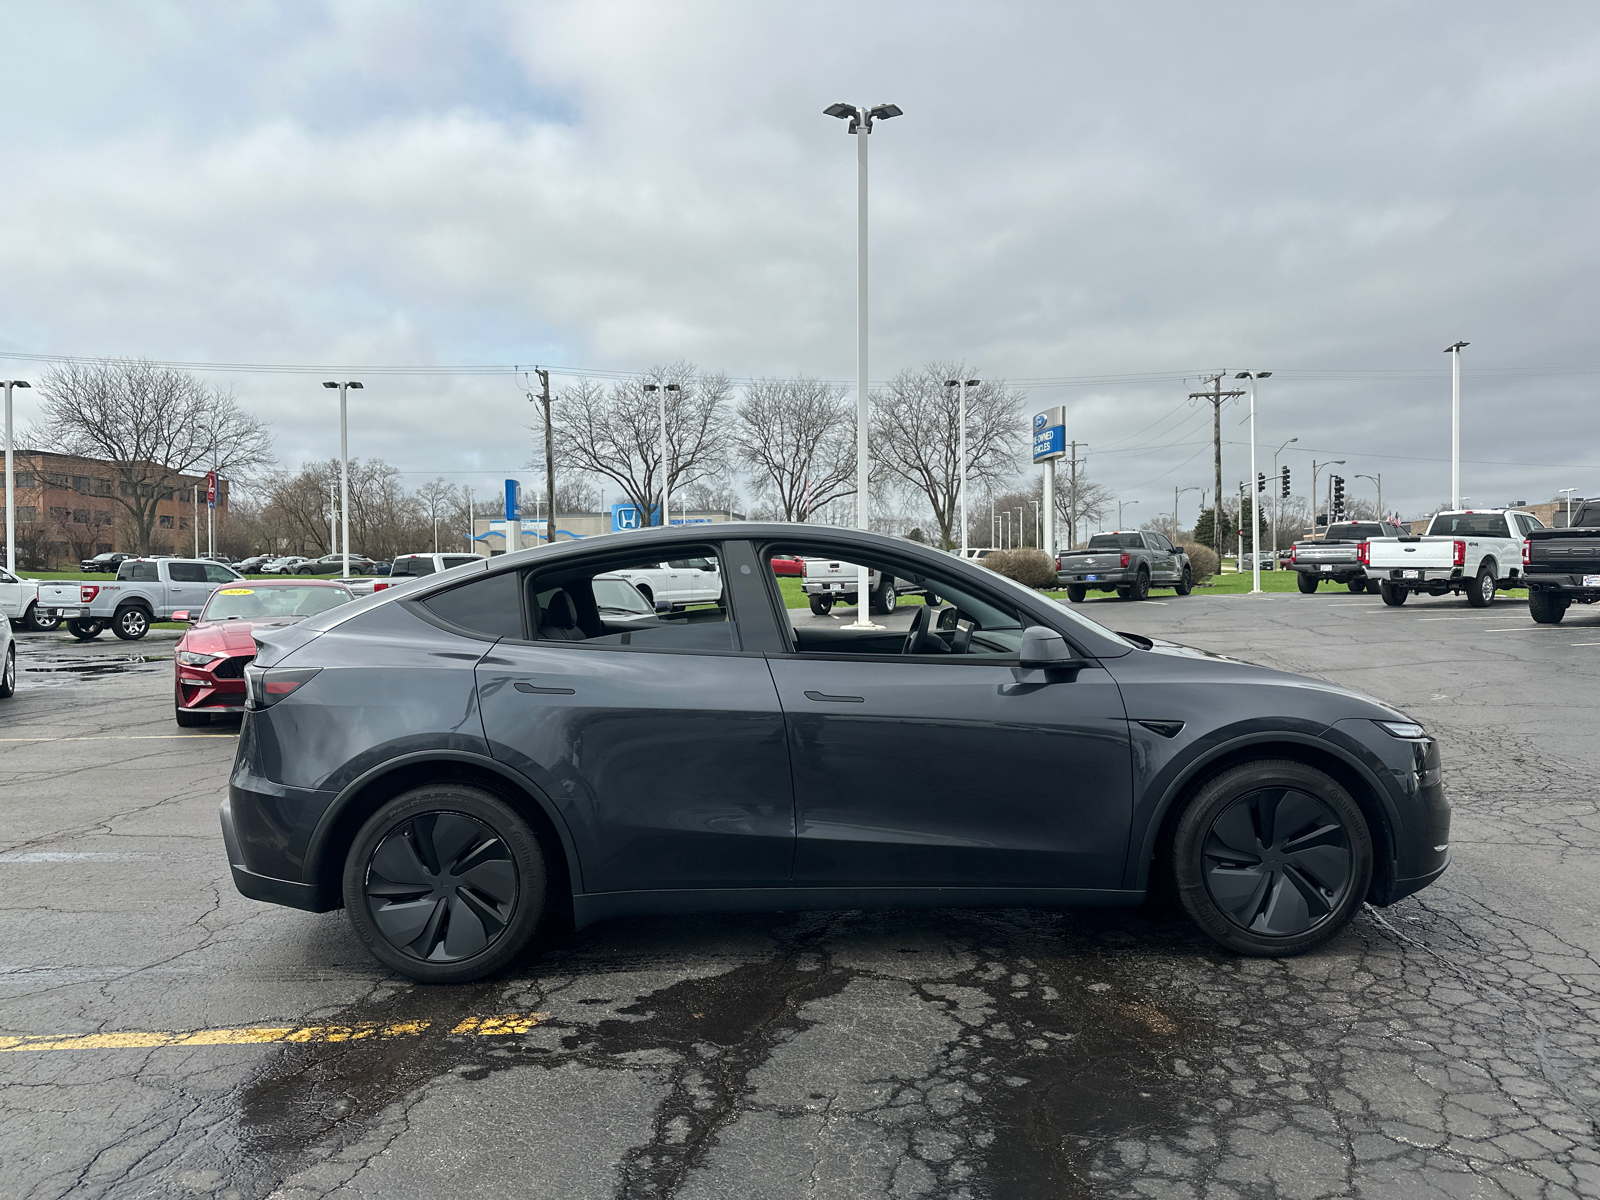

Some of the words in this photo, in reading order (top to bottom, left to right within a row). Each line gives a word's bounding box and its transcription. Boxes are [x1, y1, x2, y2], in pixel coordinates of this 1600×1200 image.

[1328, 788, 1367, 841] Continental
[510, 831, 537, 890] Continental
[347, 884, 373, 943] Continental
[1188, 888, 1228, 935] Continent
